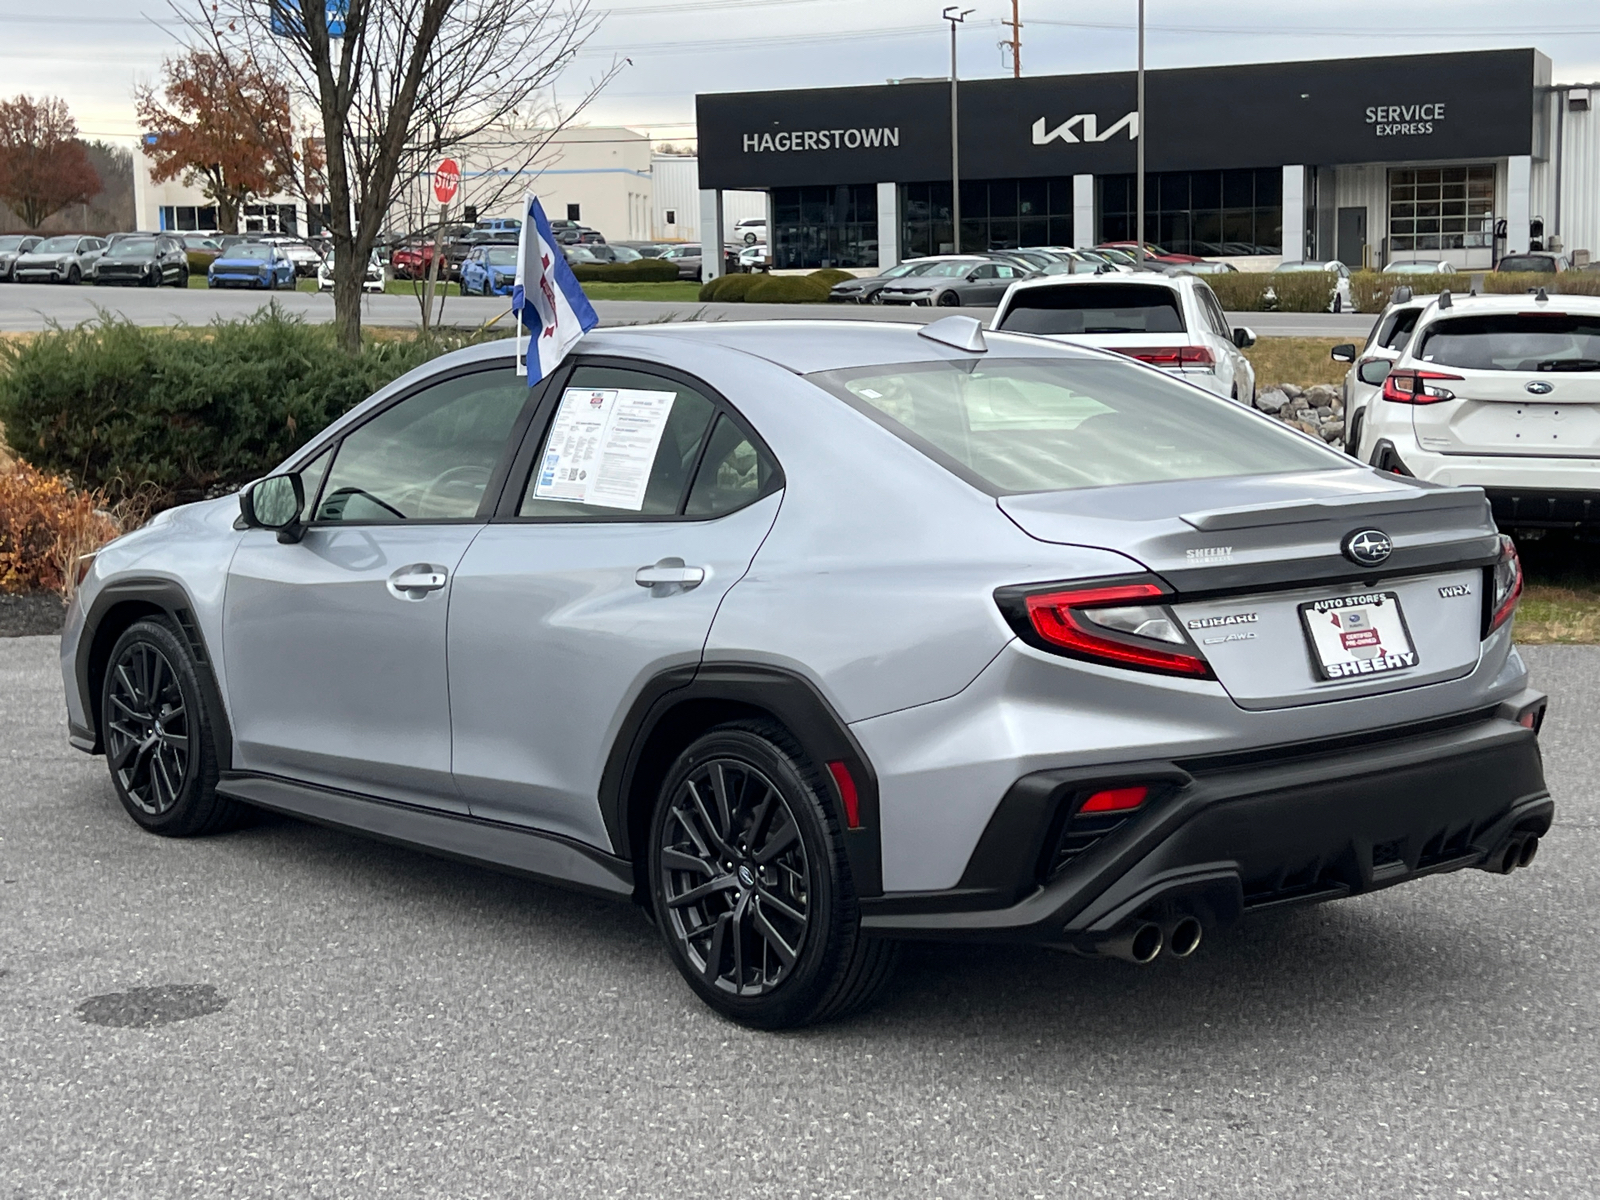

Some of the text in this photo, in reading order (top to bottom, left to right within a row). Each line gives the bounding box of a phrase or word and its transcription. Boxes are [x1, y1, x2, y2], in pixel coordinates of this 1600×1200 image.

[1366, 103, 1445, 123] SERVICE
[1376, 122, 1433, 136] EXPRESS
[743, 127, 899, 153] HAGERSTOWN
[435, 171, 459, 190] STOP
[1186, 546, 1232, 559] SHEEHY
[1438, 584, 1471, 598] WRX
[1314, 593, 1387, 610] AUTO STORES
[1188, 612, 1259, 629] SUBARU
[1327, 652, 1414, 678] SHEEHY
